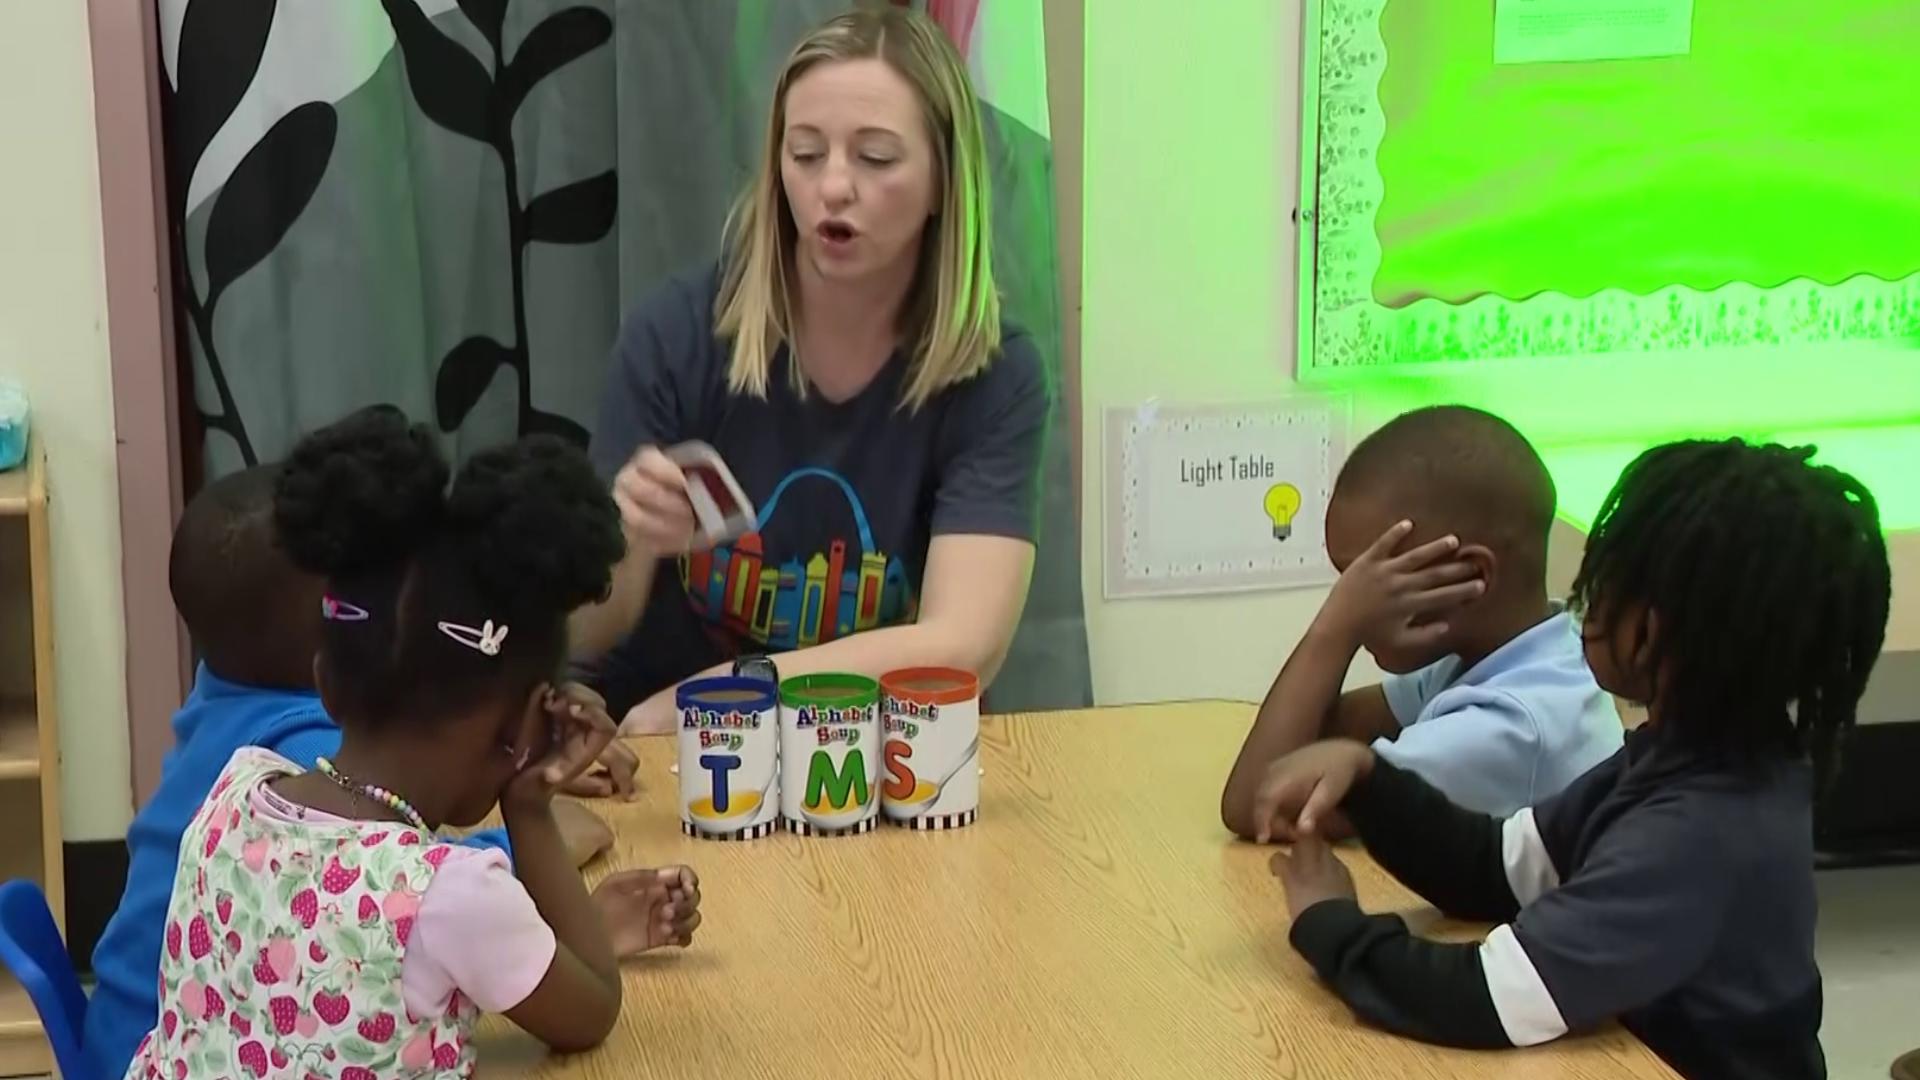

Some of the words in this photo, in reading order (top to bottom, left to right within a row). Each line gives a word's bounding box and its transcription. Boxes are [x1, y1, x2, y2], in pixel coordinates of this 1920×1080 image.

[1180, 457, 1223, 487] Light
[1229, 454, 1275, 481] Table
[683, 707, 761, 729] Alphabet
[797, 705, 874, 729] Alphabet
[699, 730, 744, 750] Soup
[816, 727, 860, 746] Soup
[699, 754, 742, 813] T
[805, 748, 868, 810] M
[884, 739, 917, 801] S
